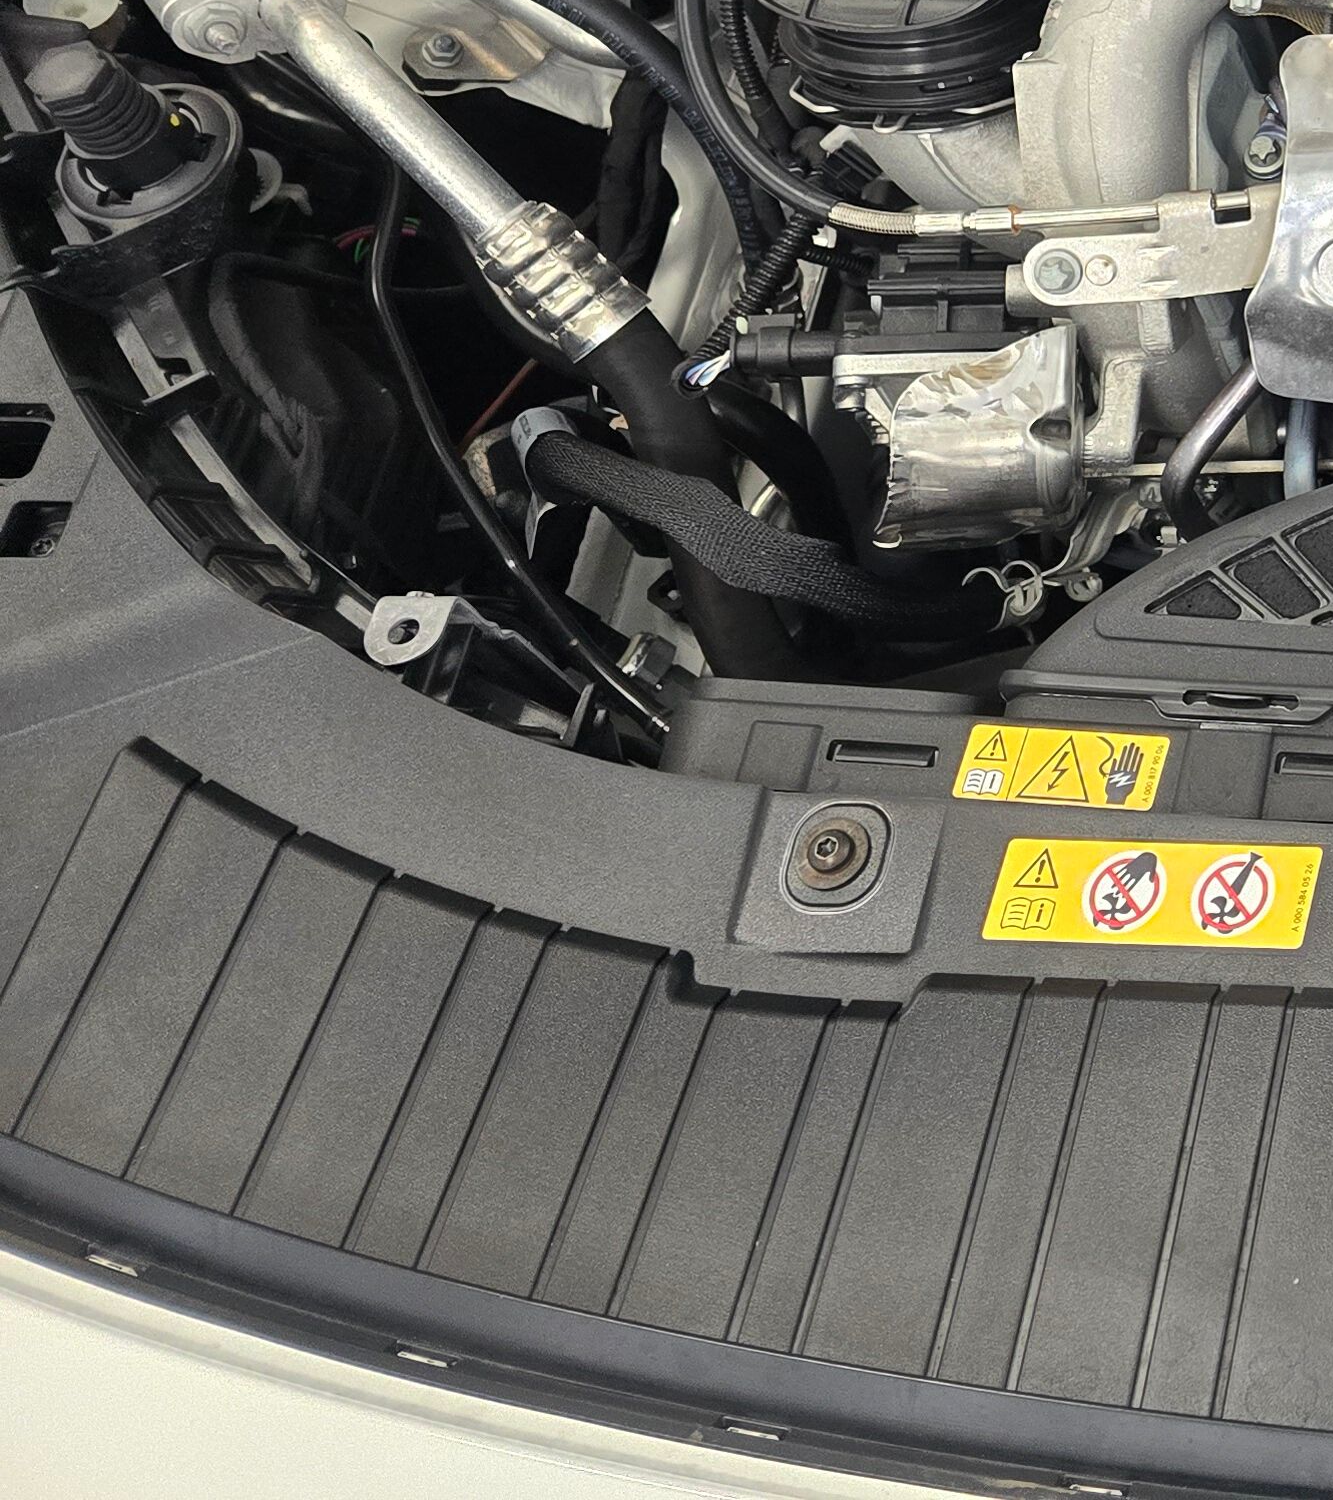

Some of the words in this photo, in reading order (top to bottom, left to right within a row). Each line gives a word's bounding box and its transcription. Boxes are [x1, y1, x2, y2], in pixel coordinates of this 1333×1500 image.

[1143, 781, 1154, 796] 000
[1304, 863, 1315, 875] 26
[1301, 876, 1311, 888] 05
[1297, 889, 1308, 906] 584
[1293, 907, 1304, 924] 000
